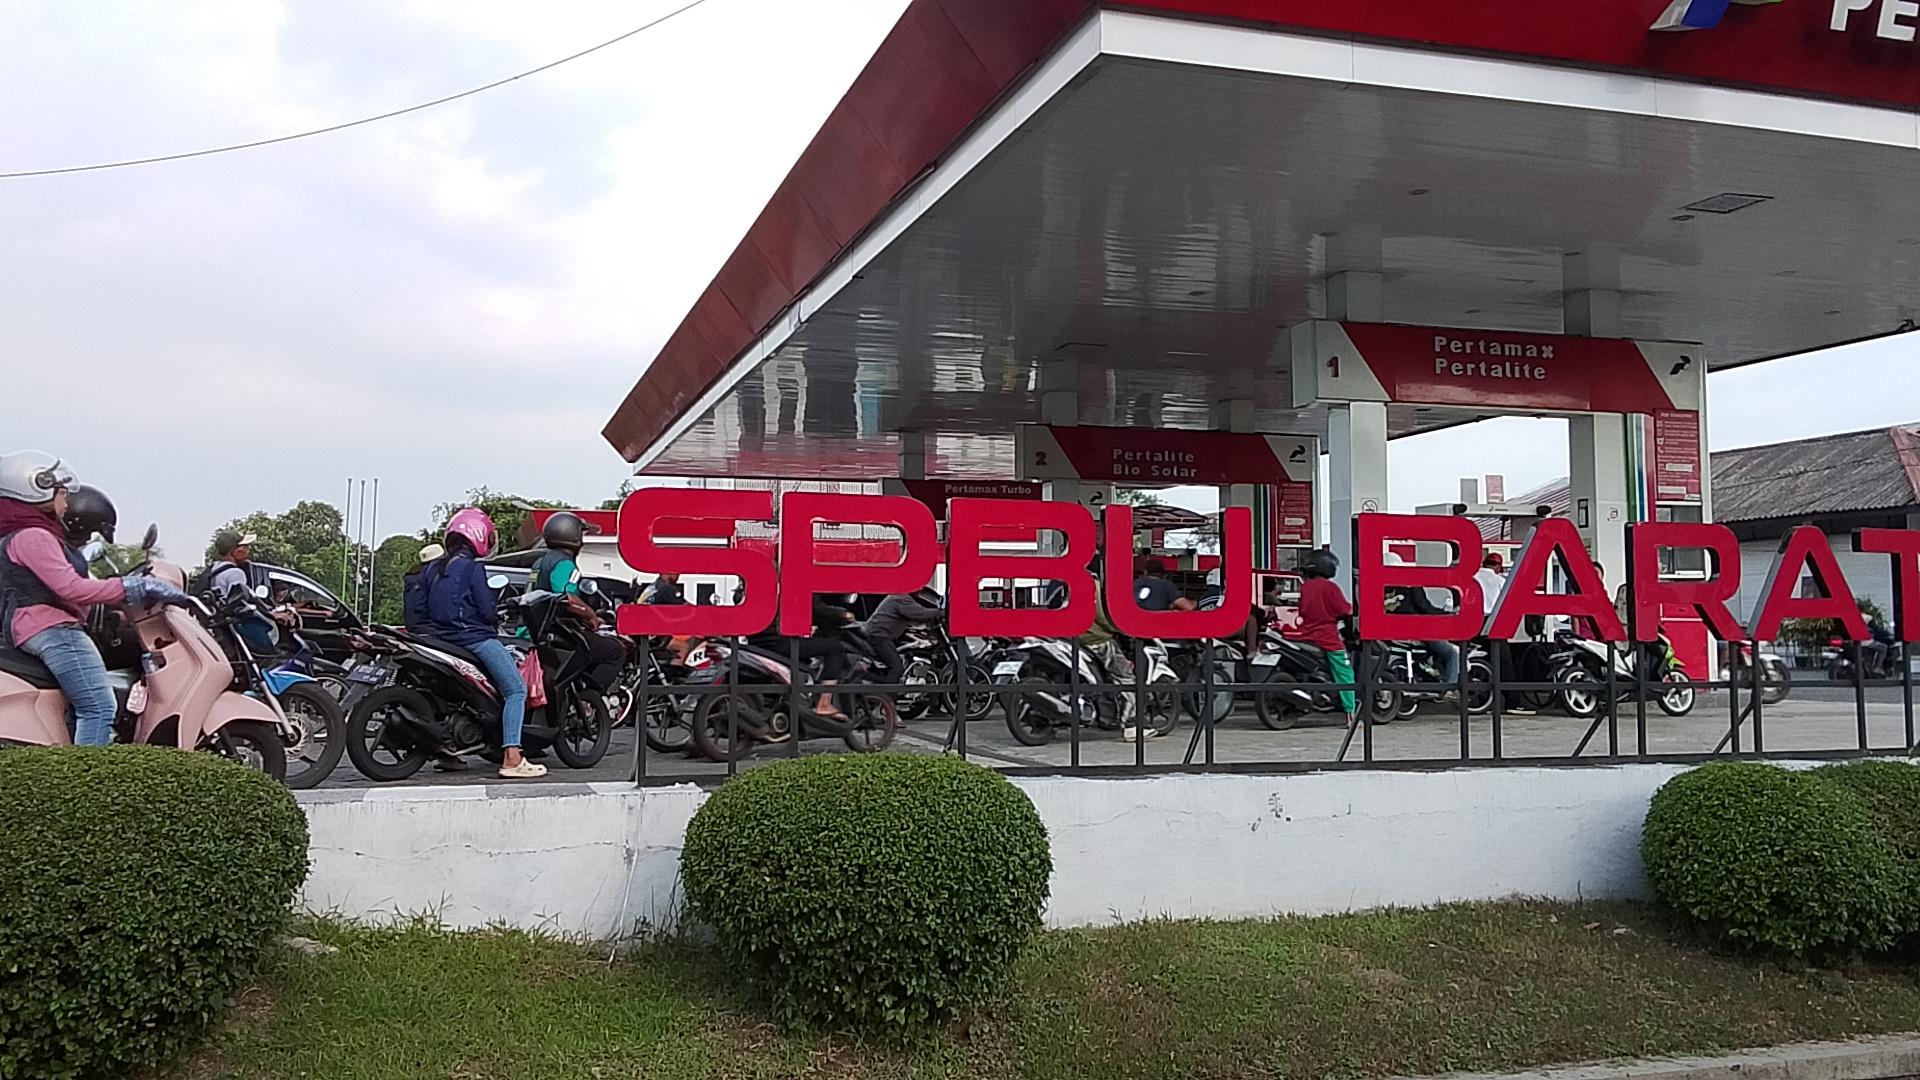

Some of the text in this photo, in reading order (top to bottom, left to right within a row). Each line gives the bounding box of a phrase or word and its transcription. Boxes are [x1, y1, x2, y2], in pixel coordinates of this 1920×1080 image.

[1434, 335, 1554, 359] Pertamax
[1326, 356, 1340, 378] 1
[1435, 358, 1547, 380] Pertalite
[1035, 451, 1048, 466] 2
[1112, 448, 1195, 463] Pertalite
[1112, 464, 1198, 478] Bio Solar
[944, 483, 1032, 495] Pertamax Turbo
[616, 486, 1920, 642] SPBU BARAT
